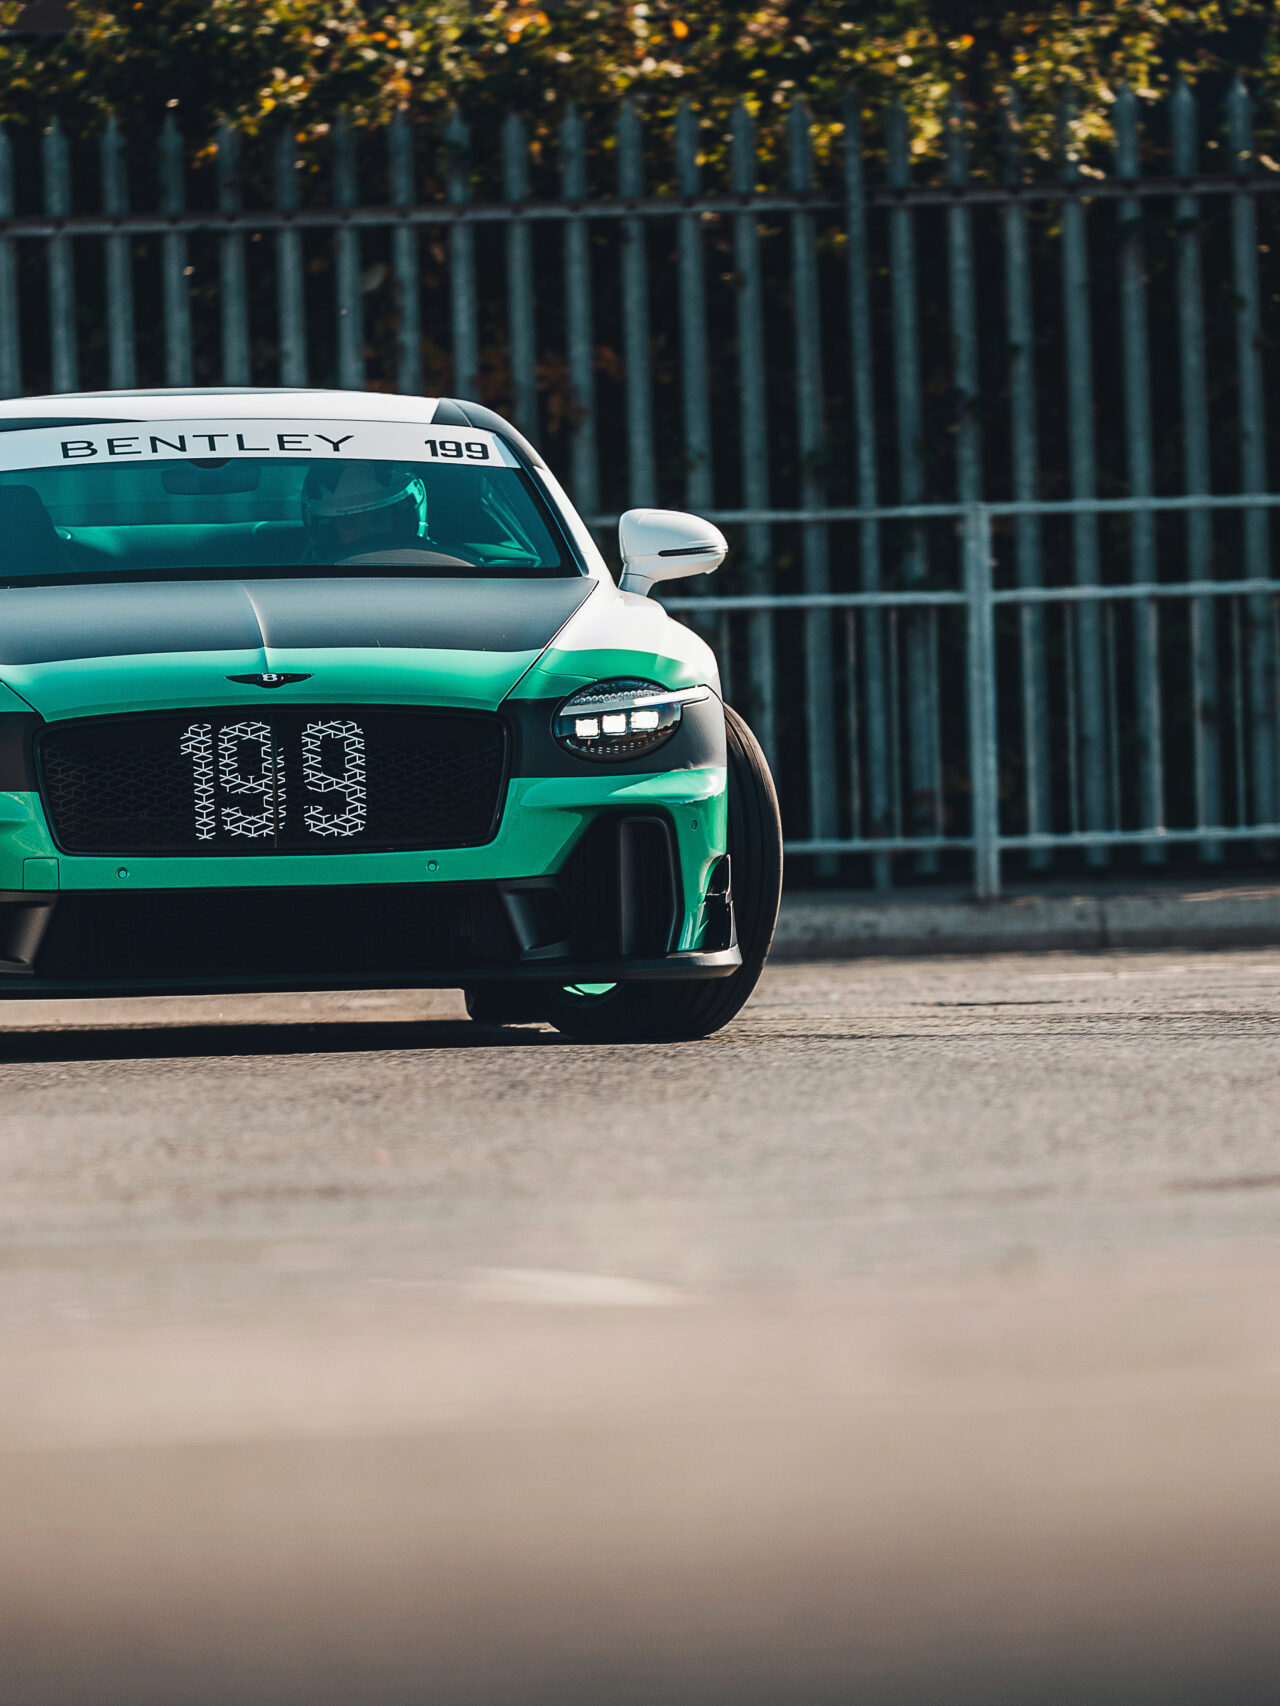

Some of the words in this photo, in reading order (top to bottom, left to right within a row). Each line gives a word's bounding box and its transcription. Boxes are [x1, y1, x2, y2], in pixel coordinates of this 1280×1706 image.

[60, 433, 355, 459] BENTLEY
[424, 439, 490, 460] 199
[180, 720, 367, 840] 199
